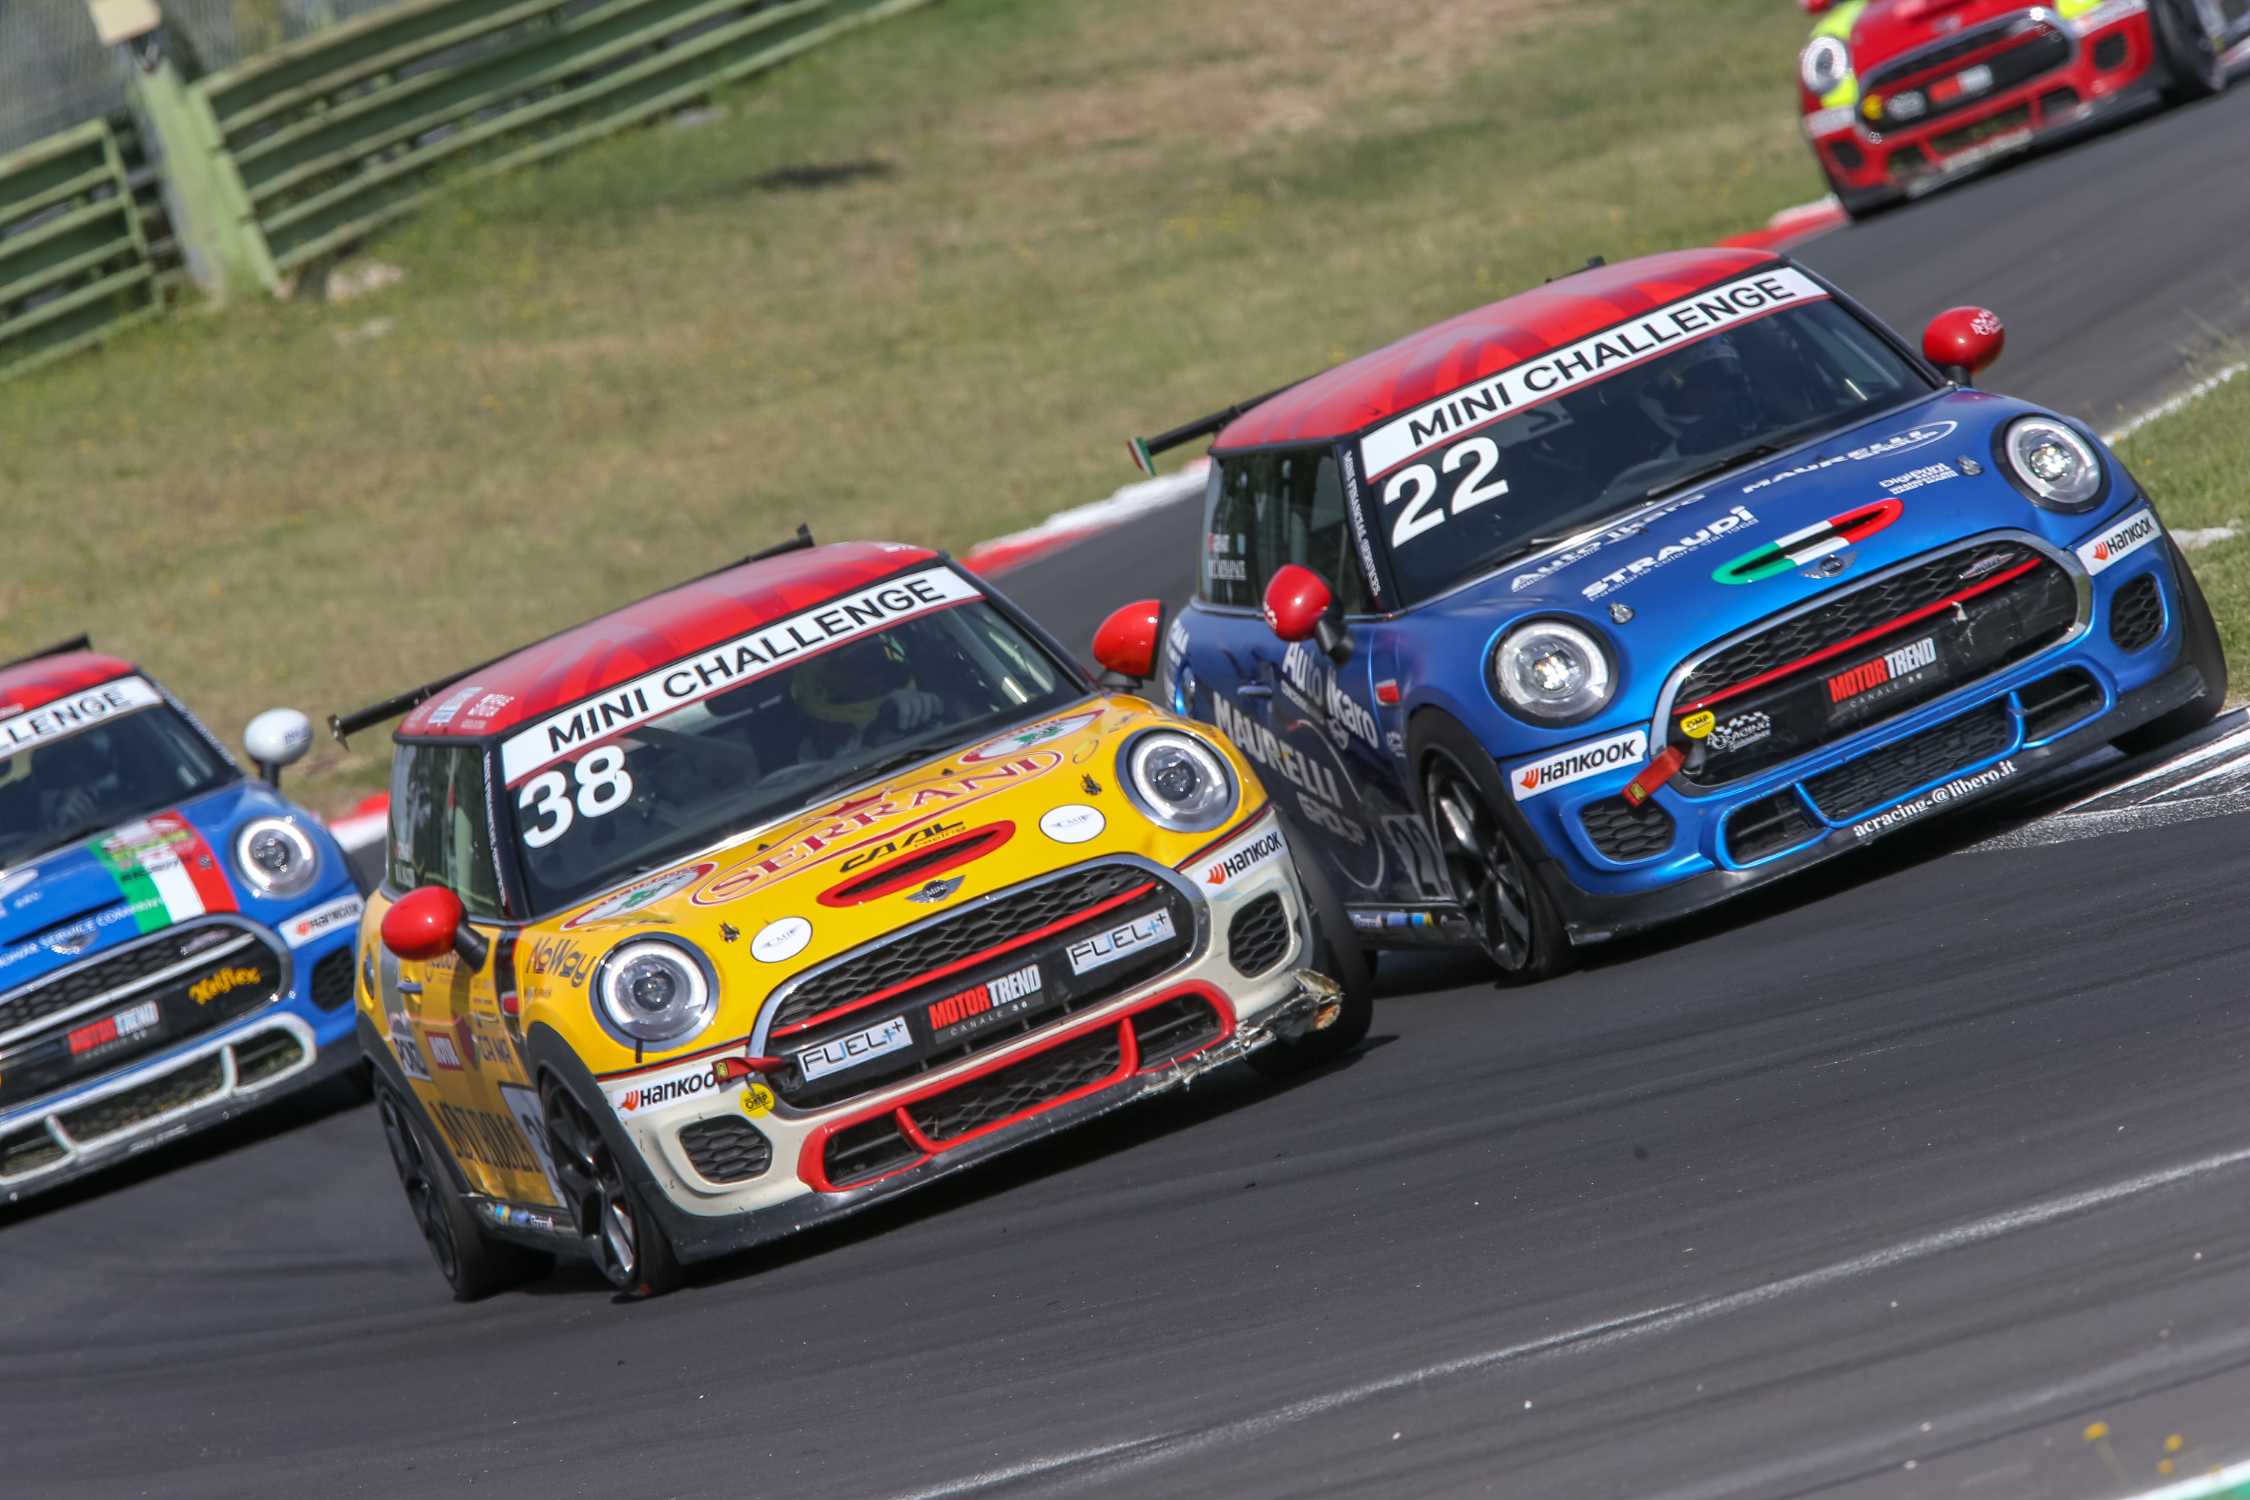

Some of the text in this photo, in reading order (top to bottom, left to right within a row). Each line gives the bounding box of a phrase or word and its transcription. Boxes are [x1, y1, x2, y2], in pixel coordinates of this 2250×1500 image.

[1408, 278, 1797, 447] MINI CHALLENGE
[1384, 436, 1509, 550] 22
[0, 684, 131, 752] LENGE
[547, 578, 946, 753] MINI CHALLENGE
[517, 744, 634, 849] 38
[1213, 690, 1343, 809] MAURELLI
[708, 757, 1040, 898] SERRANI
